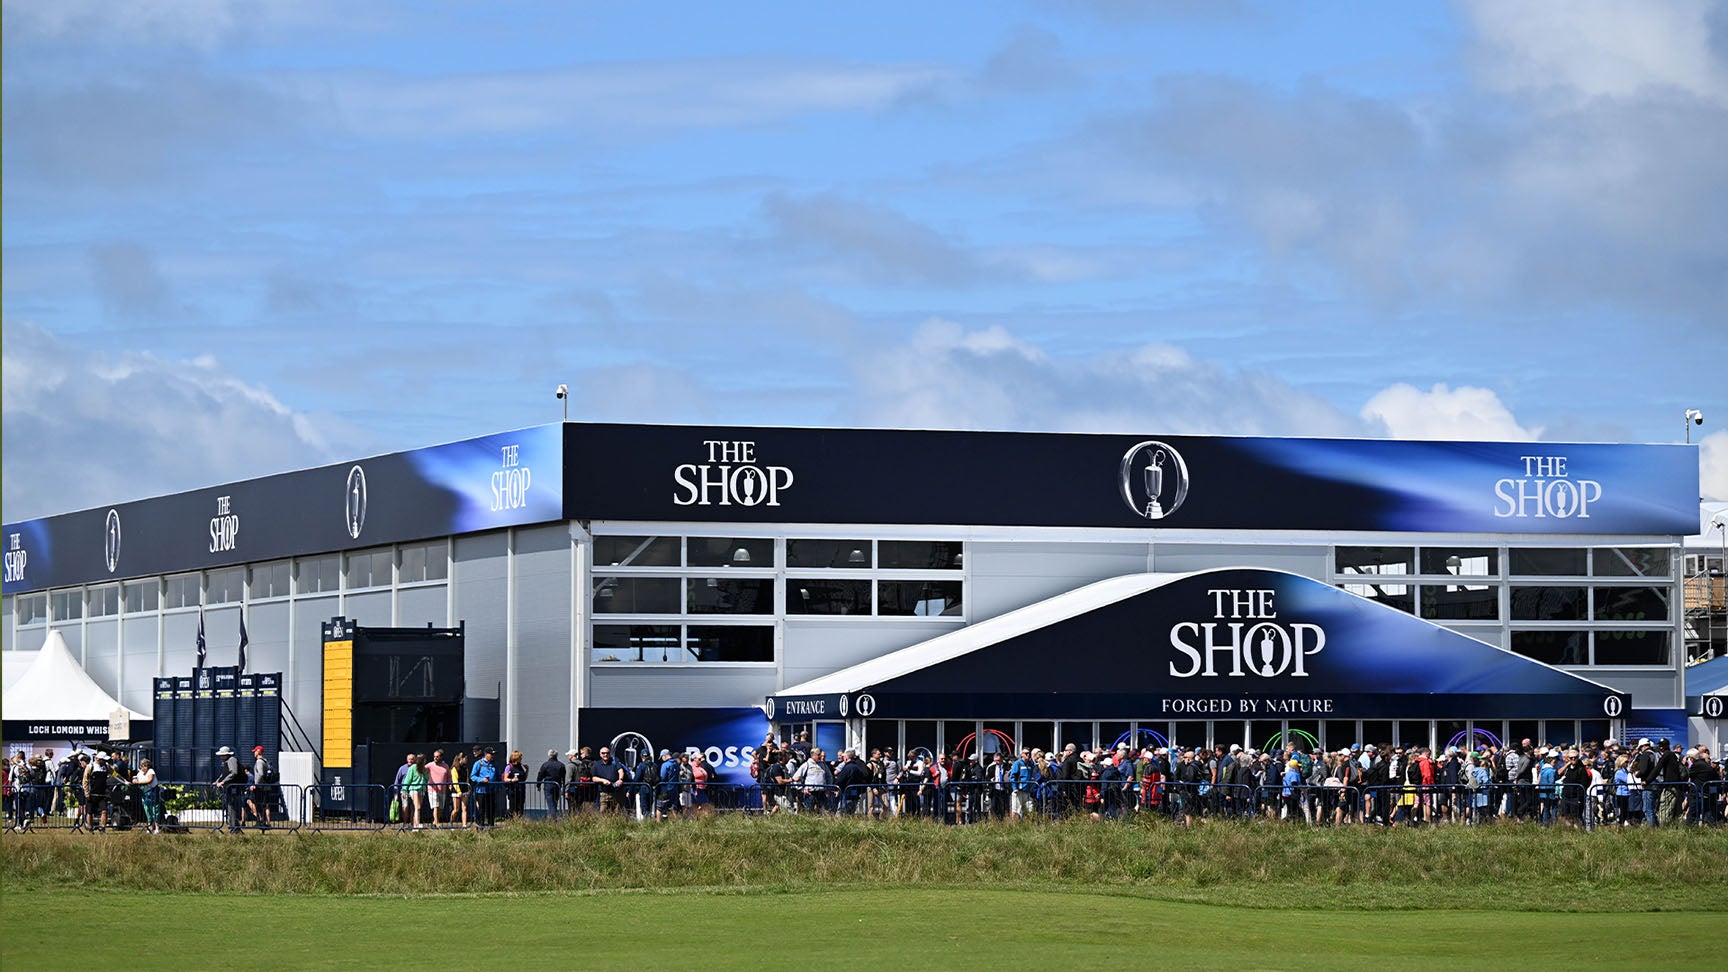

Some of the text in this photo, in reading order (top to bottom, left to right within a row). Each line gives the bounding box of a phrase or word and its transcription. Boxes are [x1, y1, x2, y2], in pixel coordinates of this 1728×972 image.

[501, 445, 519, 468] THE
[703, 440, 757, 463] THE
[1520, 456, 1569, 478] THE
[491, 468, 531, 512] SHOP
[673, 464, 794, 507] SHOP
[217, 496, 230, 515] THE
[1494, 479, 1602, 519] SHOP
[10, 533, 20, 550] THE
[209, 515, 239, 552] SHOP
[5, 550, 27, 582] SHOP
[1207, 589, 1277, 619] THE
[1169, 621, 1327, 678] SHOP
[786, 700, 826, 715] ENTRANCE
[1162, 699, 1333, 713] FORGED BY NATURE
[28, 725, 50, 735] LOCH
[51, 725, 85, 735] LOMOND
[86, 725, 109, 735] WHIS
